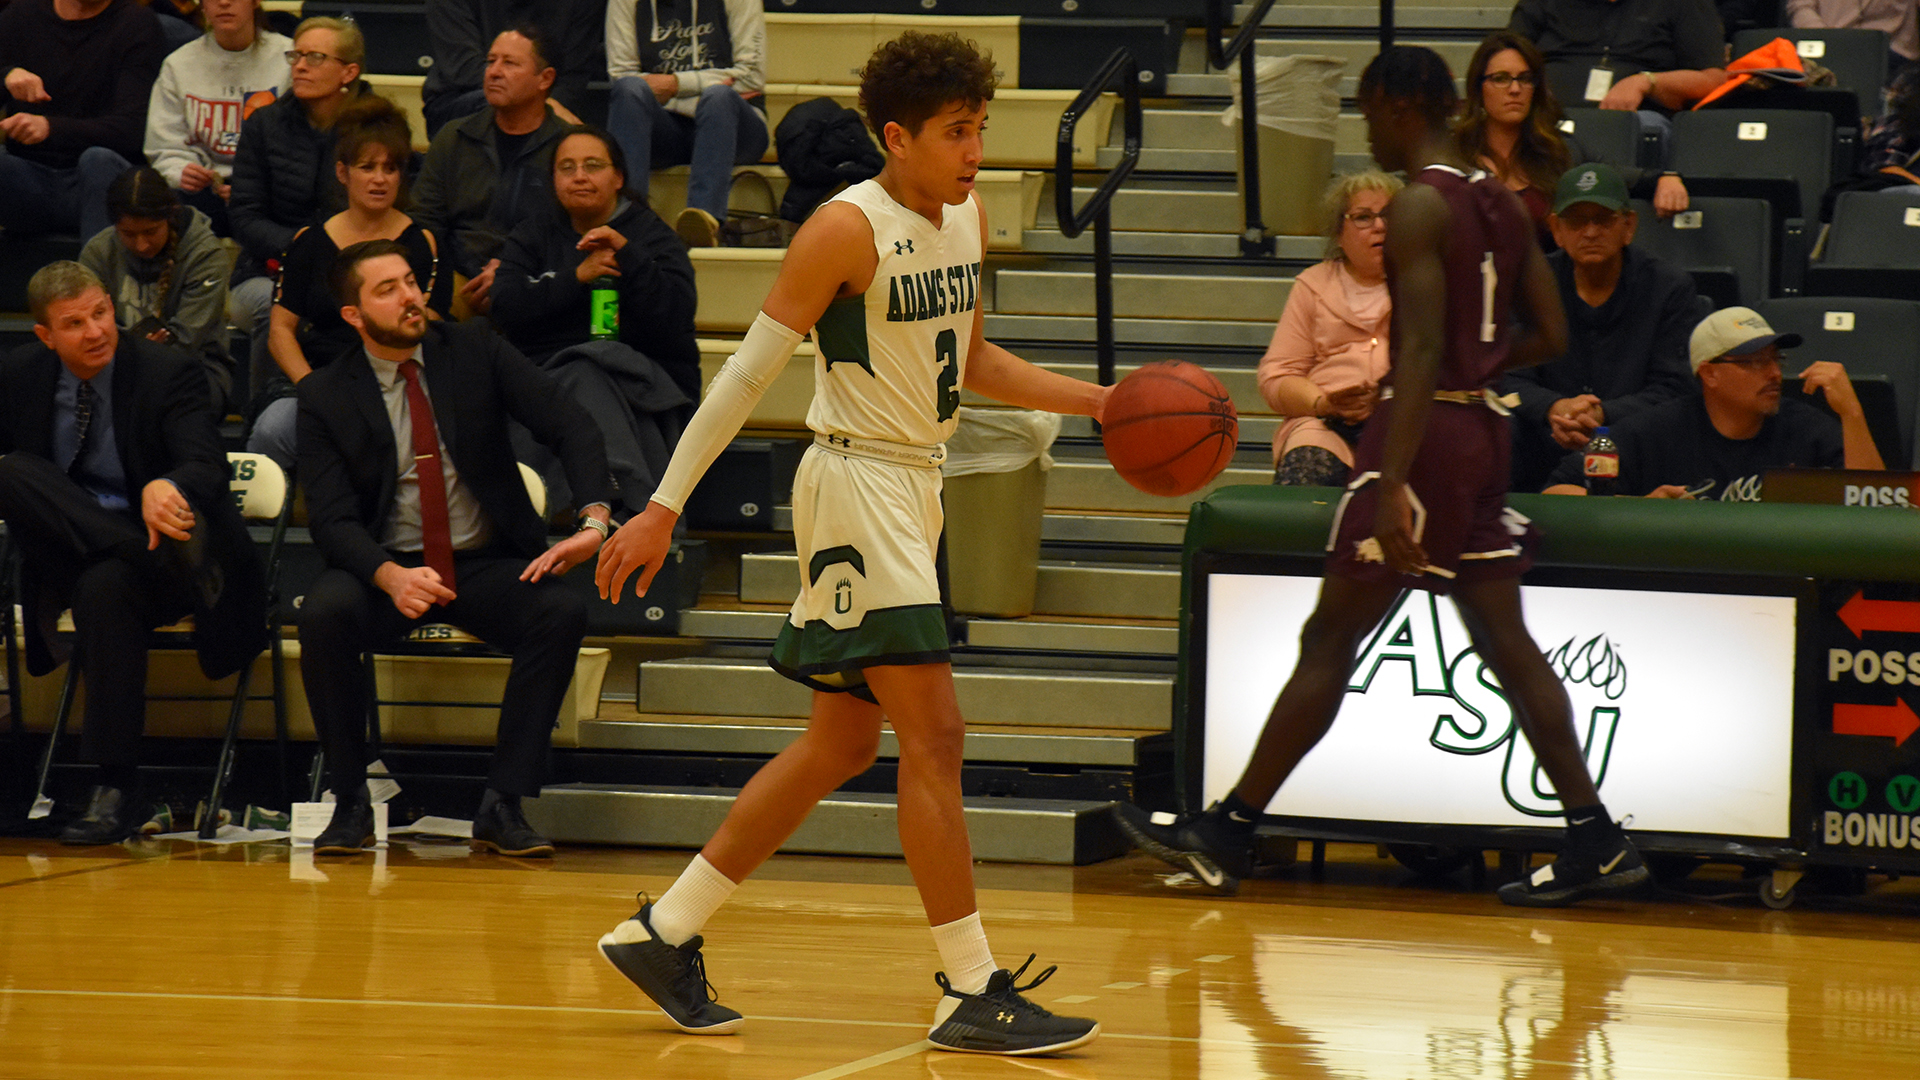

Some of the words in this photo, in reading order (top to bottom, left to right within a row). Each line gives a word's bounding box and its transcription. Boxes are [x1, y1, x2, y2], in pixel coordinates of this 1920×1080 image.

[887, 268, 946, 322] ADAMS
[1480, 251, 1498, 342] 1
[935, 328, 960, 423] 2
[853, 442, 897, 457] ARMOUR
[898, 451, 928, 462] UNDER
[1844, 485, 1910, 508] POSS
[1828, 648, 1920, 686] POSS
[1836, 778, 1859, 803] H
[1894, 783, 1918, 808] V
[1824, 811, 1920, 850] BONUS
